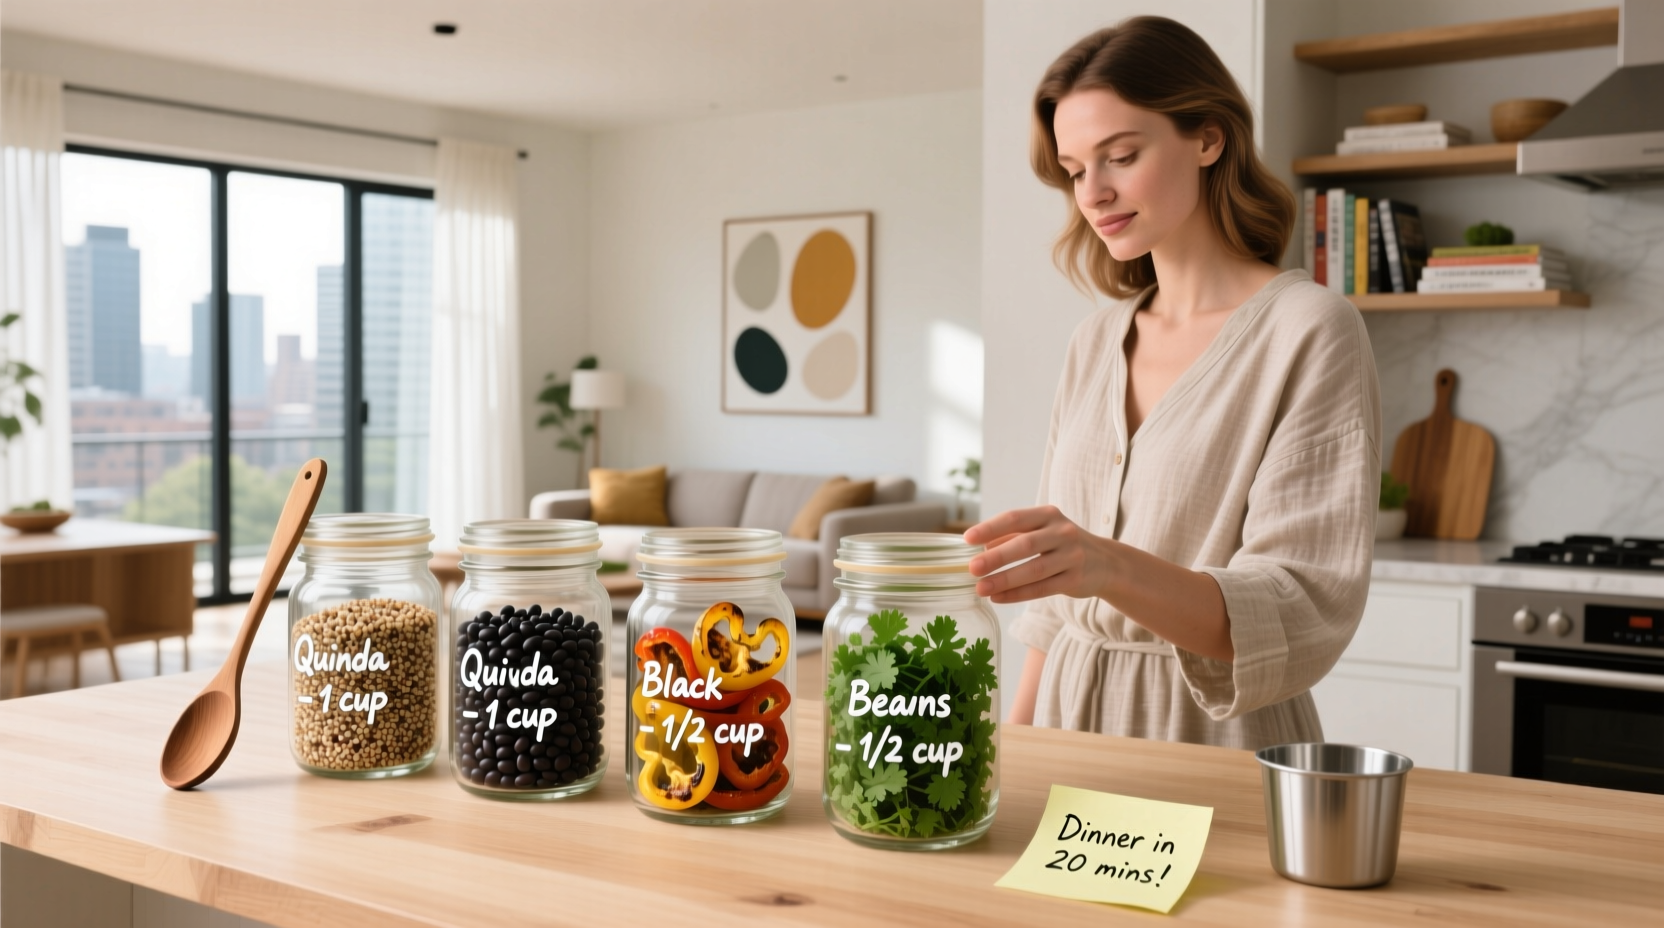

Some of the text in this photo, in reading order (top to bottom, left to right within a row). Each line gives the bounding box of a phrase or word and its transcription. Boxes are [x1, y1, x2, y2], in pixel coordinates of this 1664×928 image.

[294, 633, 390, 677] Quinda
[641, 660, 723, 700] Black
[339, 691, 388, 725] cup
[506, 707, 558, 742] cup
[714, 722, 764, 757] cup
[912, 742, 963, 778] cup
[1057, 813, 1175, 855] Dinner in
[1045, 849, 1172, 888] 20 mins!
